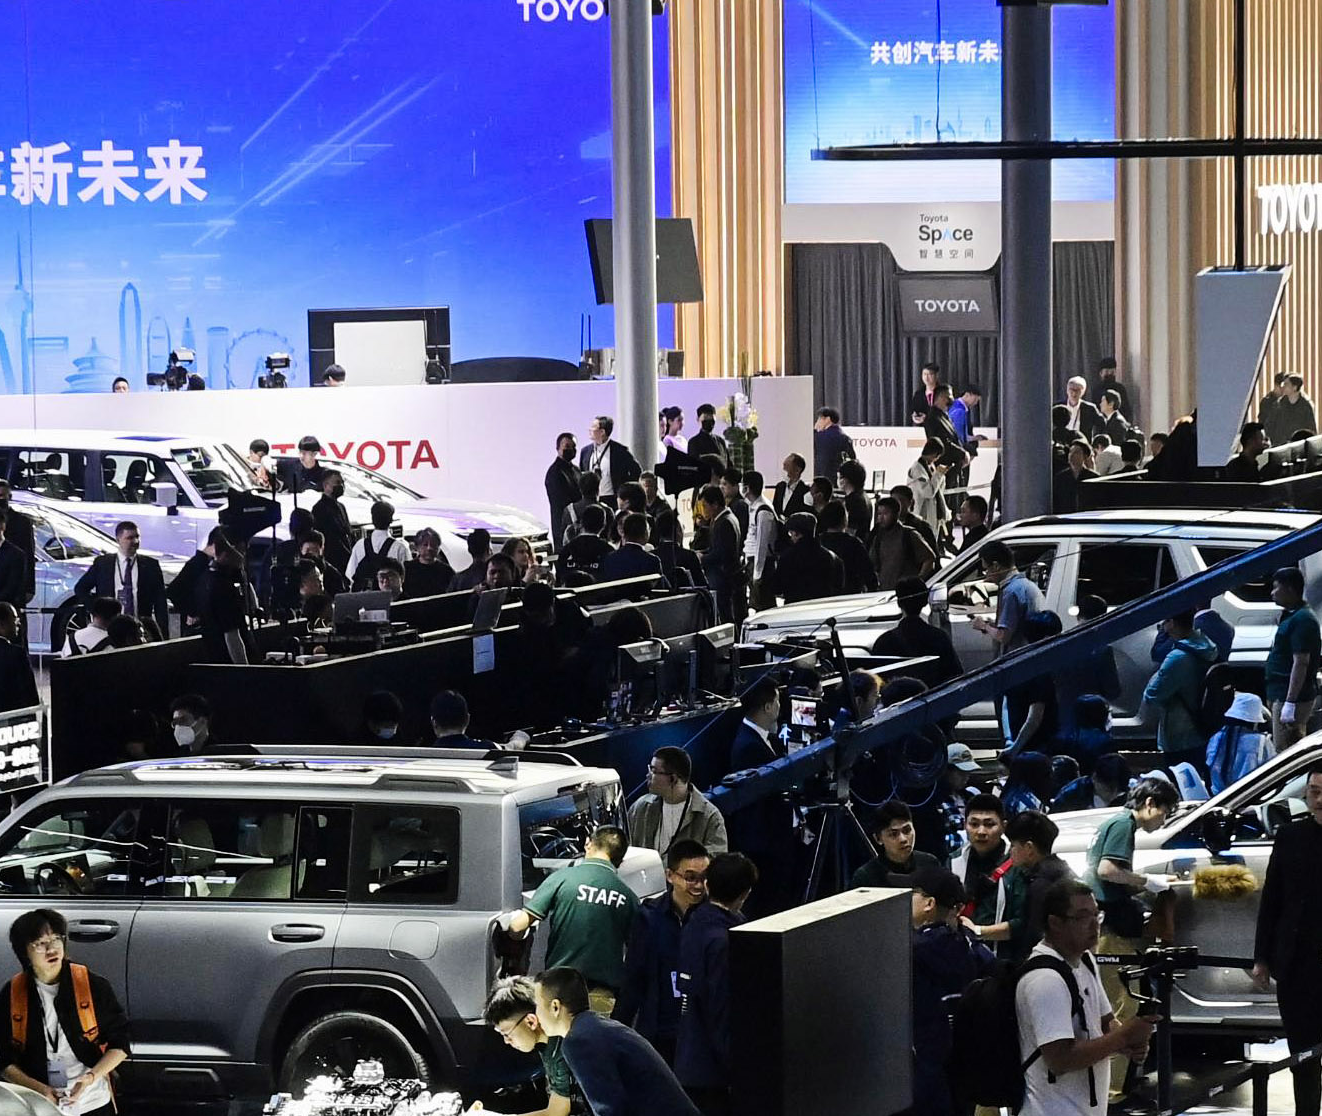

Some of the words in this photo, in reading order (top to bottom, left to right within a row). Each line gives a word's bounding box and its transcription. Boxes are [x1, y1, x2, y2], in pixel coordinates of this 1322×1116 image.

[516, 0, 605, 22] TOYO
[870, 39, 1001, 64] 共创汽车新未
[920, 213, 949, 224] Toyota
[914, 299, 981, 313] TOYOTA
[853, 438, 897, 448] TOYOTA
[577, 884, 626, 909] STAFF
[1097, 956, 1120, 964] GWM
